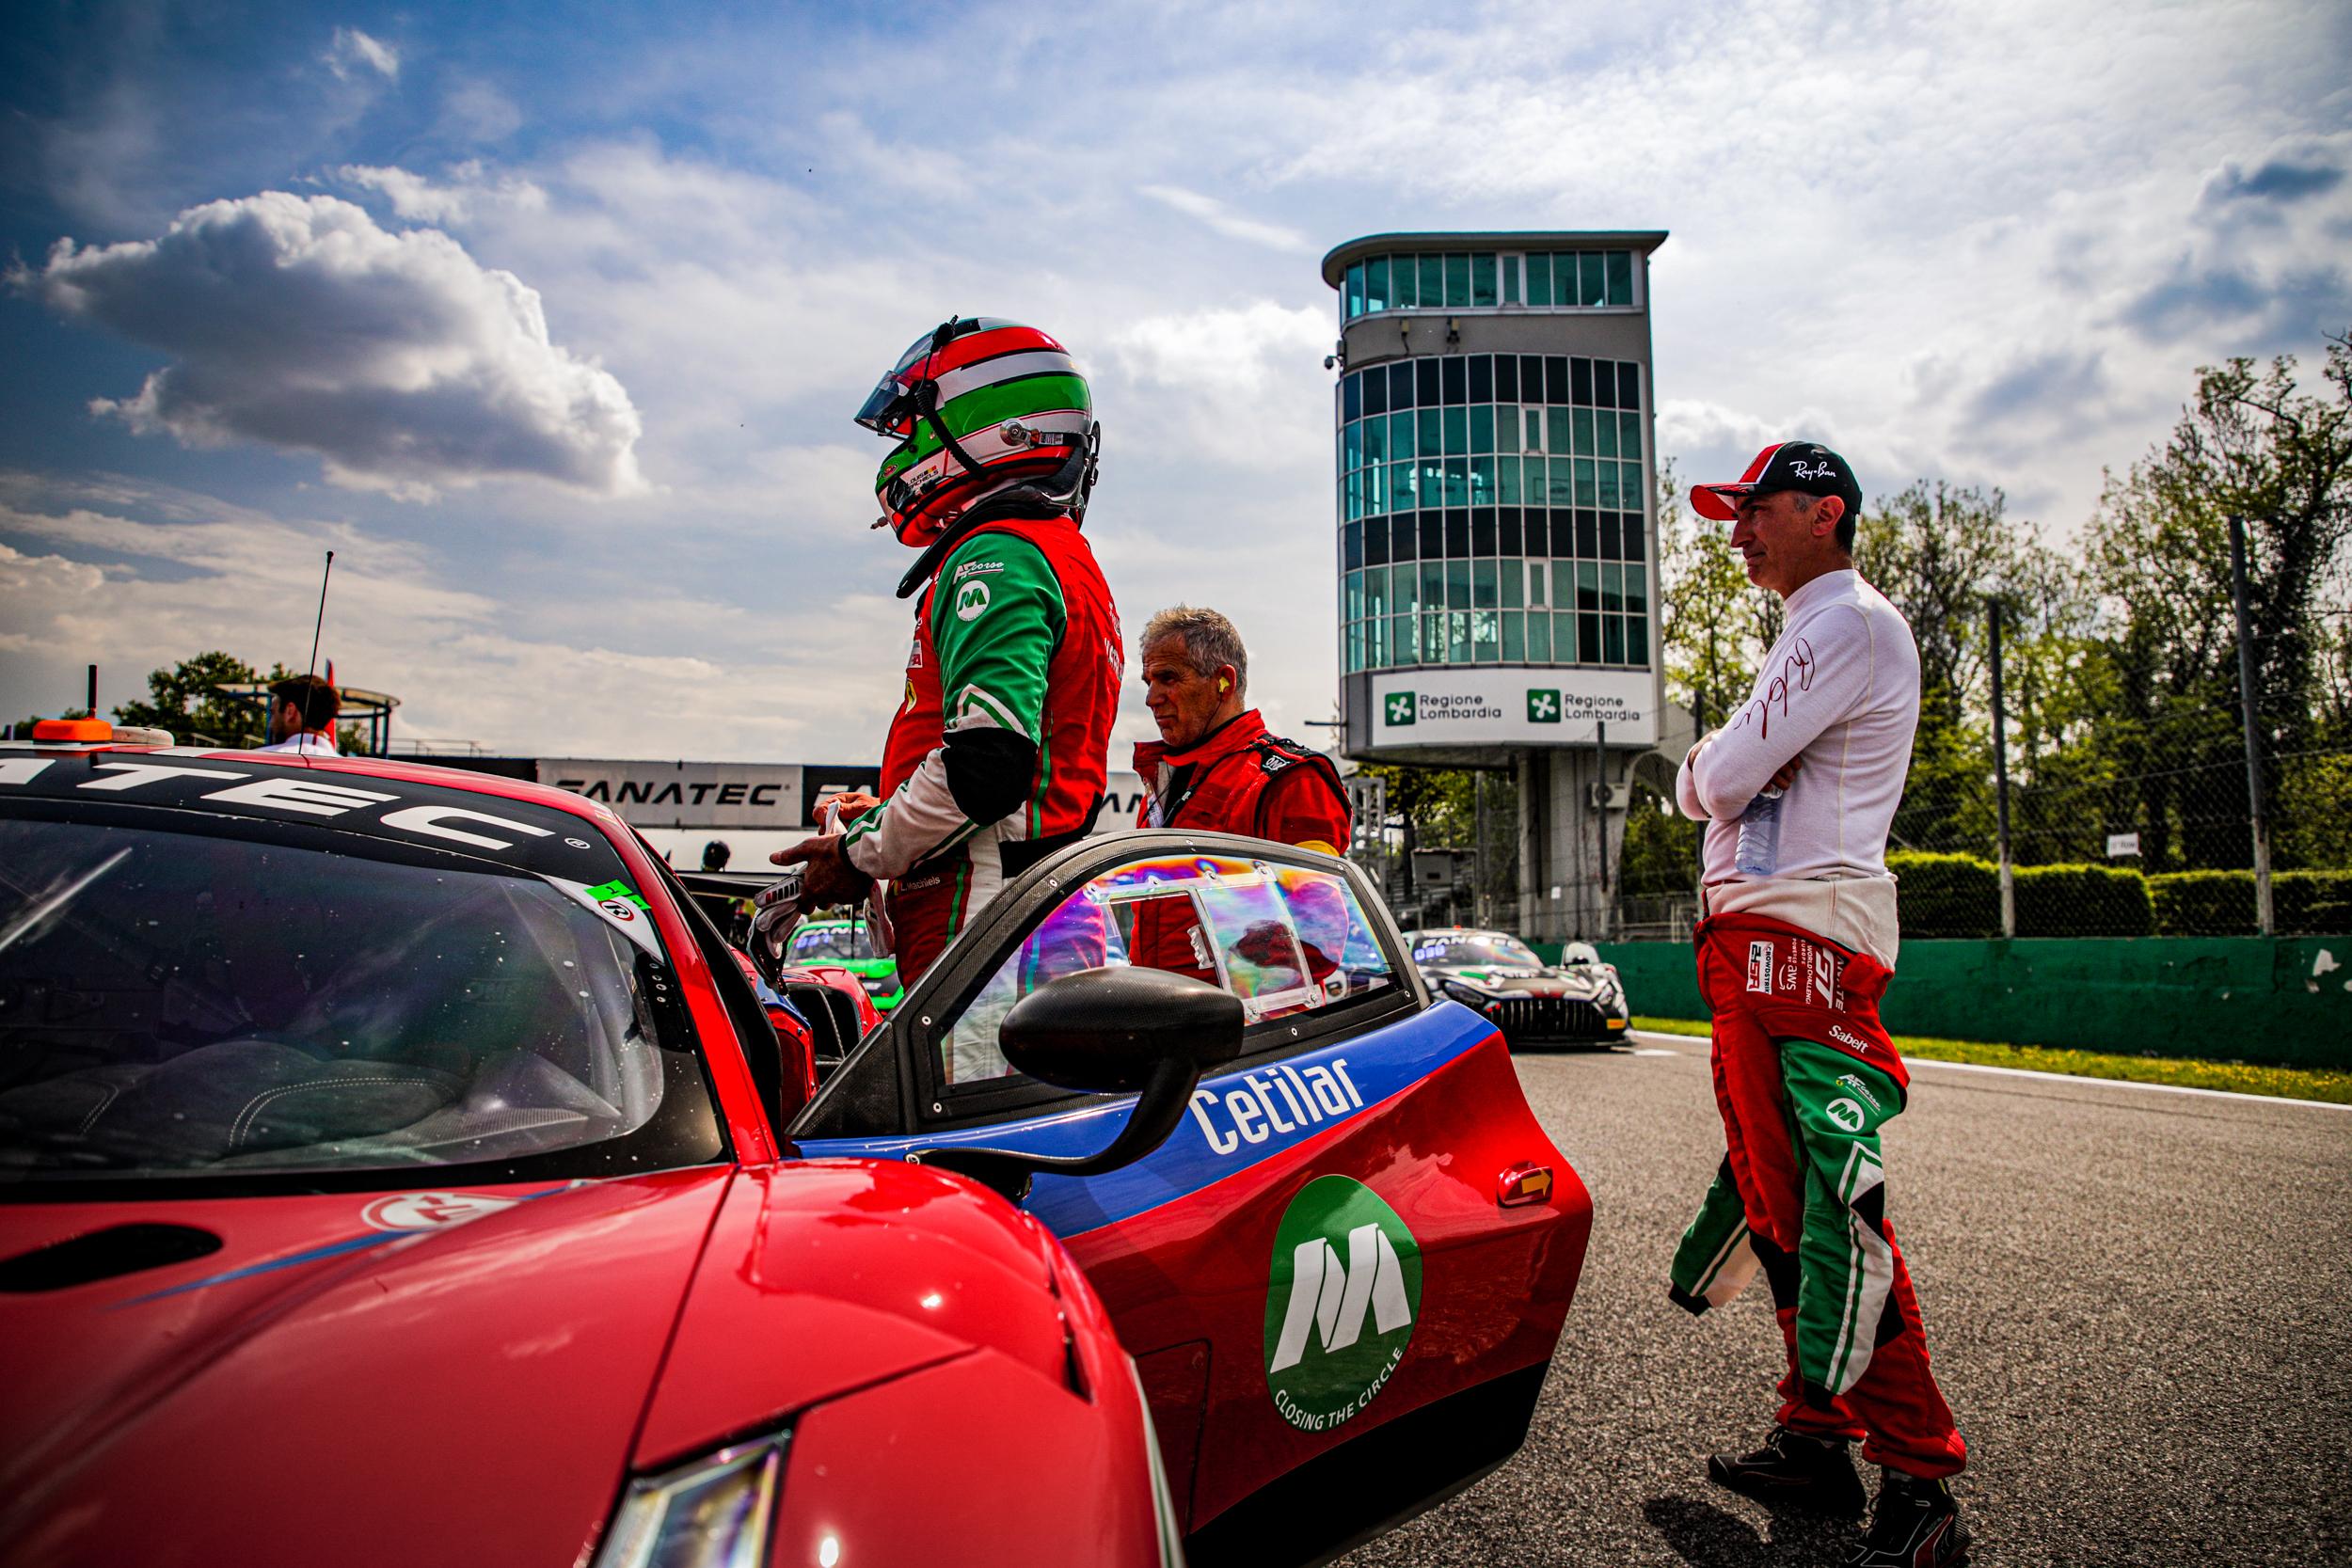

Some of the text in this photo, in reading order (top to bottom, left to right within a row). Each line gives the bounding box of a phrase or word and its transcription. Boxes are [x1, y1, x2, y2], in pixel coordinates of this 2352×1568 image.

[1420, 694, 1484, 706] Regione
[1565, 693, 1624, 707] Regione
[1420, 707, 1502, 721] Lombardia
[1565, 708, 1641, 721] Lombardia
[1787, 964, 1798, 990] aws
[1815, 946, 1835, 1009] GT
[1828, 1024, 1868, 1053] Sabelt
[1187, 1058, 1364, 1155] Cetilar
[1275, 1347, 1404, 1430] CLOSING THE CIRCLE
